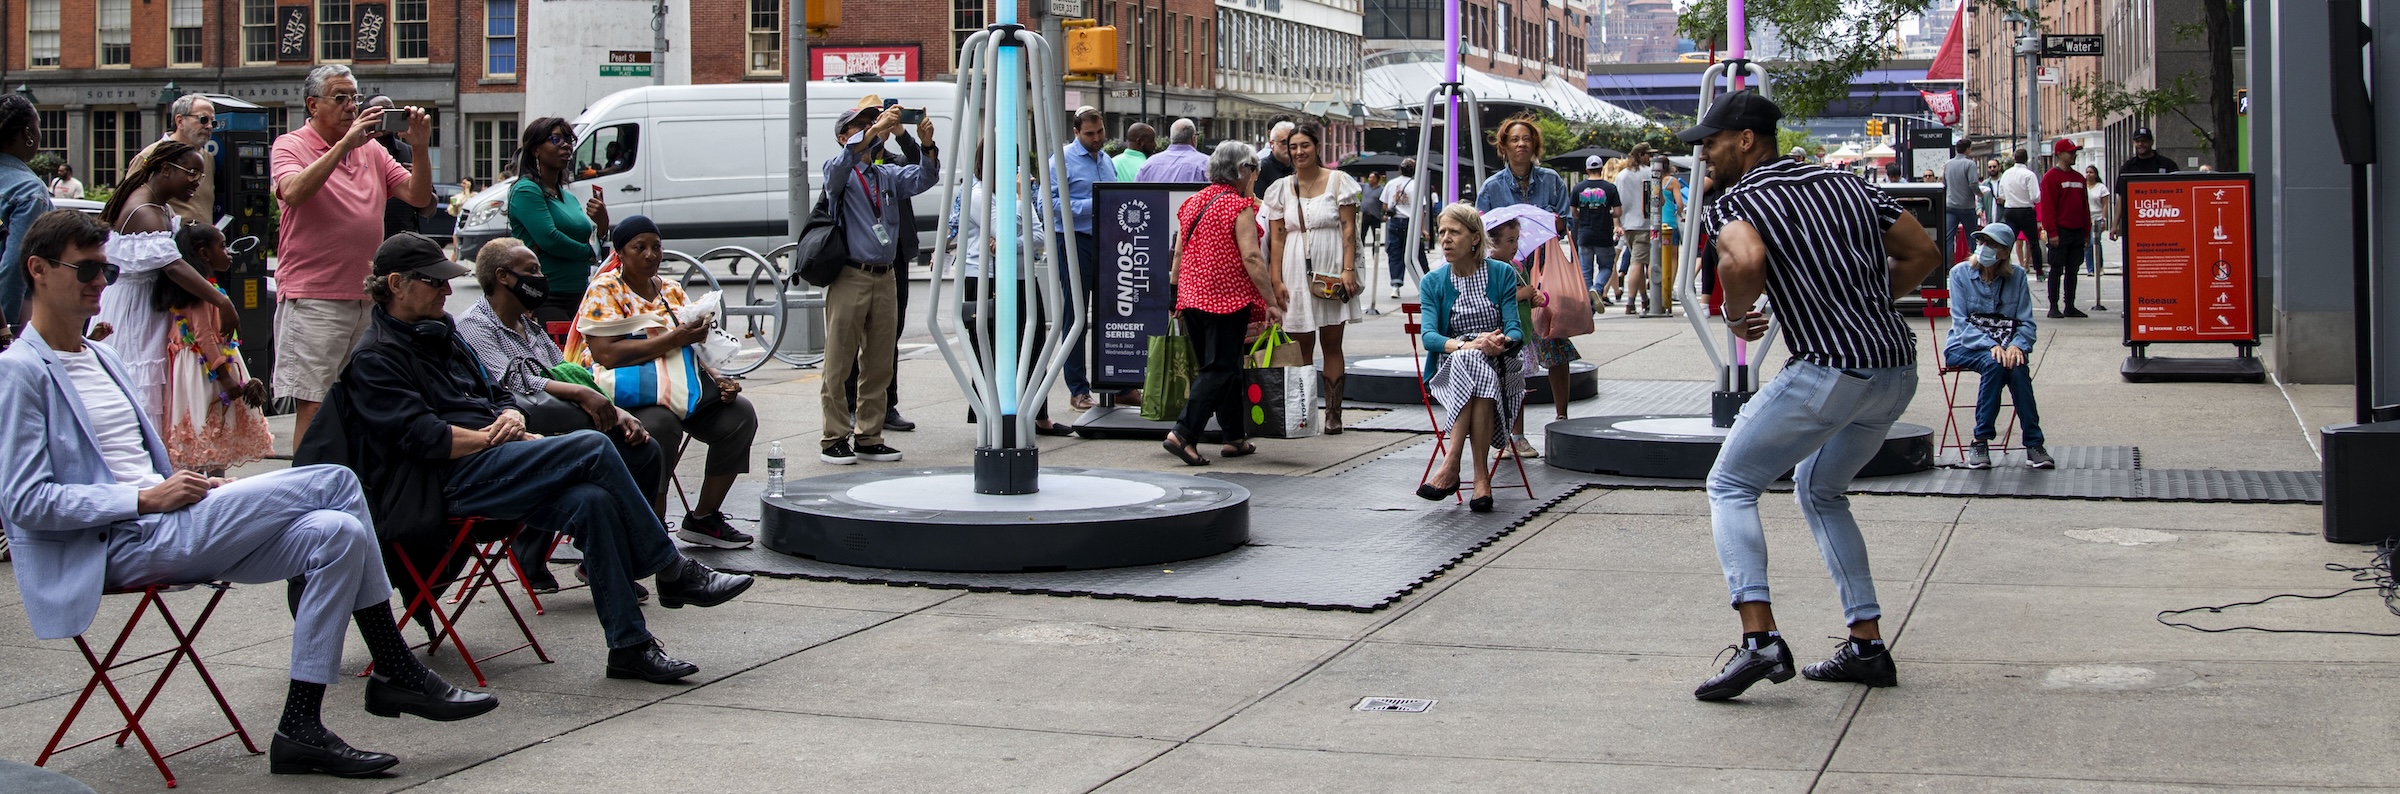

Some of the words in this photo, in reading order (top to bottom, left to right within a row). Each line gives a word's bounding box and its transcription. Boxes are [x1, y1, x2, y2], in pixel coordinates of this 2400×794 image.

[1053, 3, 1065, 12] OVER
[1066, 4, 1072, 13] 33
[1073, 5, 1079, 13] FT
[281, 9, 303, 54] STAPLE
[356, 8, 375, 50] FANCY
[367, 15, 384, 53] GOODS
[292, 23, 306, 52] AND
[2065, 41, 2092, 52] Water
[611, 53, 627, 62] Pearl
[628, 53, 635, 62] St
[847, 58, 879, 67] SEAPORT
[87, 90, 136, 98] SOUTH
[228, 87, 300, 96] SEAPORT
[1111, 90, 1128, 98] WATER
[1131, 89, 1139, 97] ST
[1132, 199, 1148, 210] ART
[2134, 199, 2166, 209] LIGHT
[1117, 203, 1133, 234] AROUND
[1144, 211, 1150, 220] IS
[2138, 208, 2180, 218] SOUND
[1134, 221, 1149, 233] ALL
[1133, 235, 1150, 292] LIGHT
[1117, 241, 1134, 317] SOUND
[1105, 323, 1144, 331] CONCERT
[1105, 331, 1135, 339] SERIES
